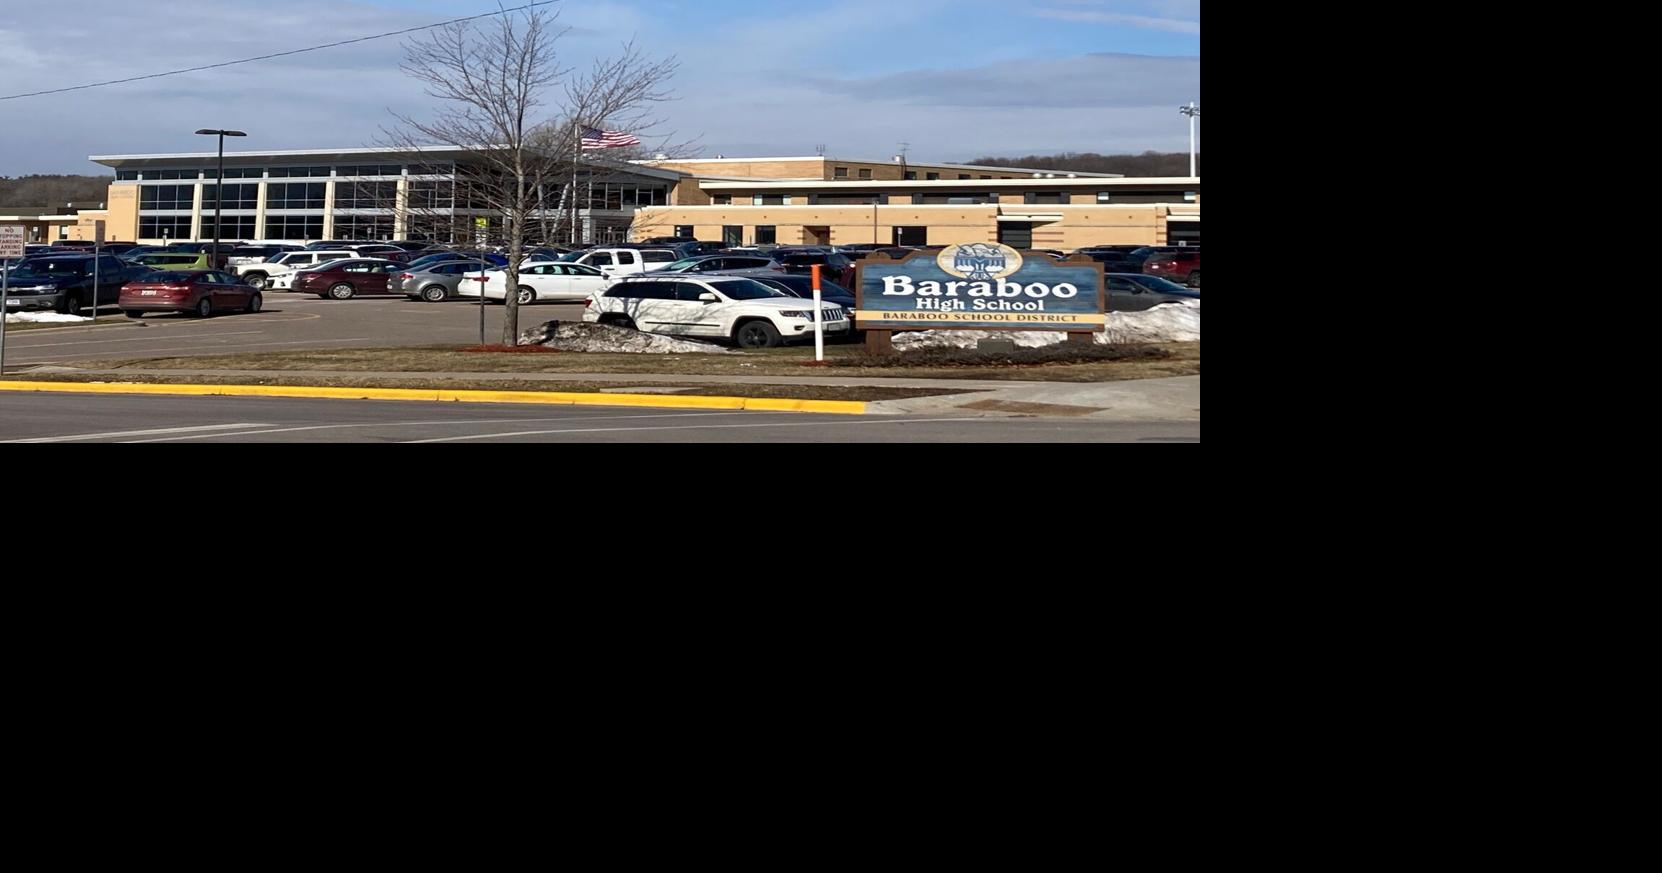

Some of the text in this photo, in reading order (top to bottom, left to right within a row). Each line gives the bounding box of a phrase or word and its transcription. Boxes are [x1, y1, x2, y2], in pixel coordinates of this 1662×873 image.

[881, 275, 1078, 298] Baraboo
[916, 297, 1045, 312] High School
[883, 312, 1078, 322] BARABOO SCHOOL DISTRICT
